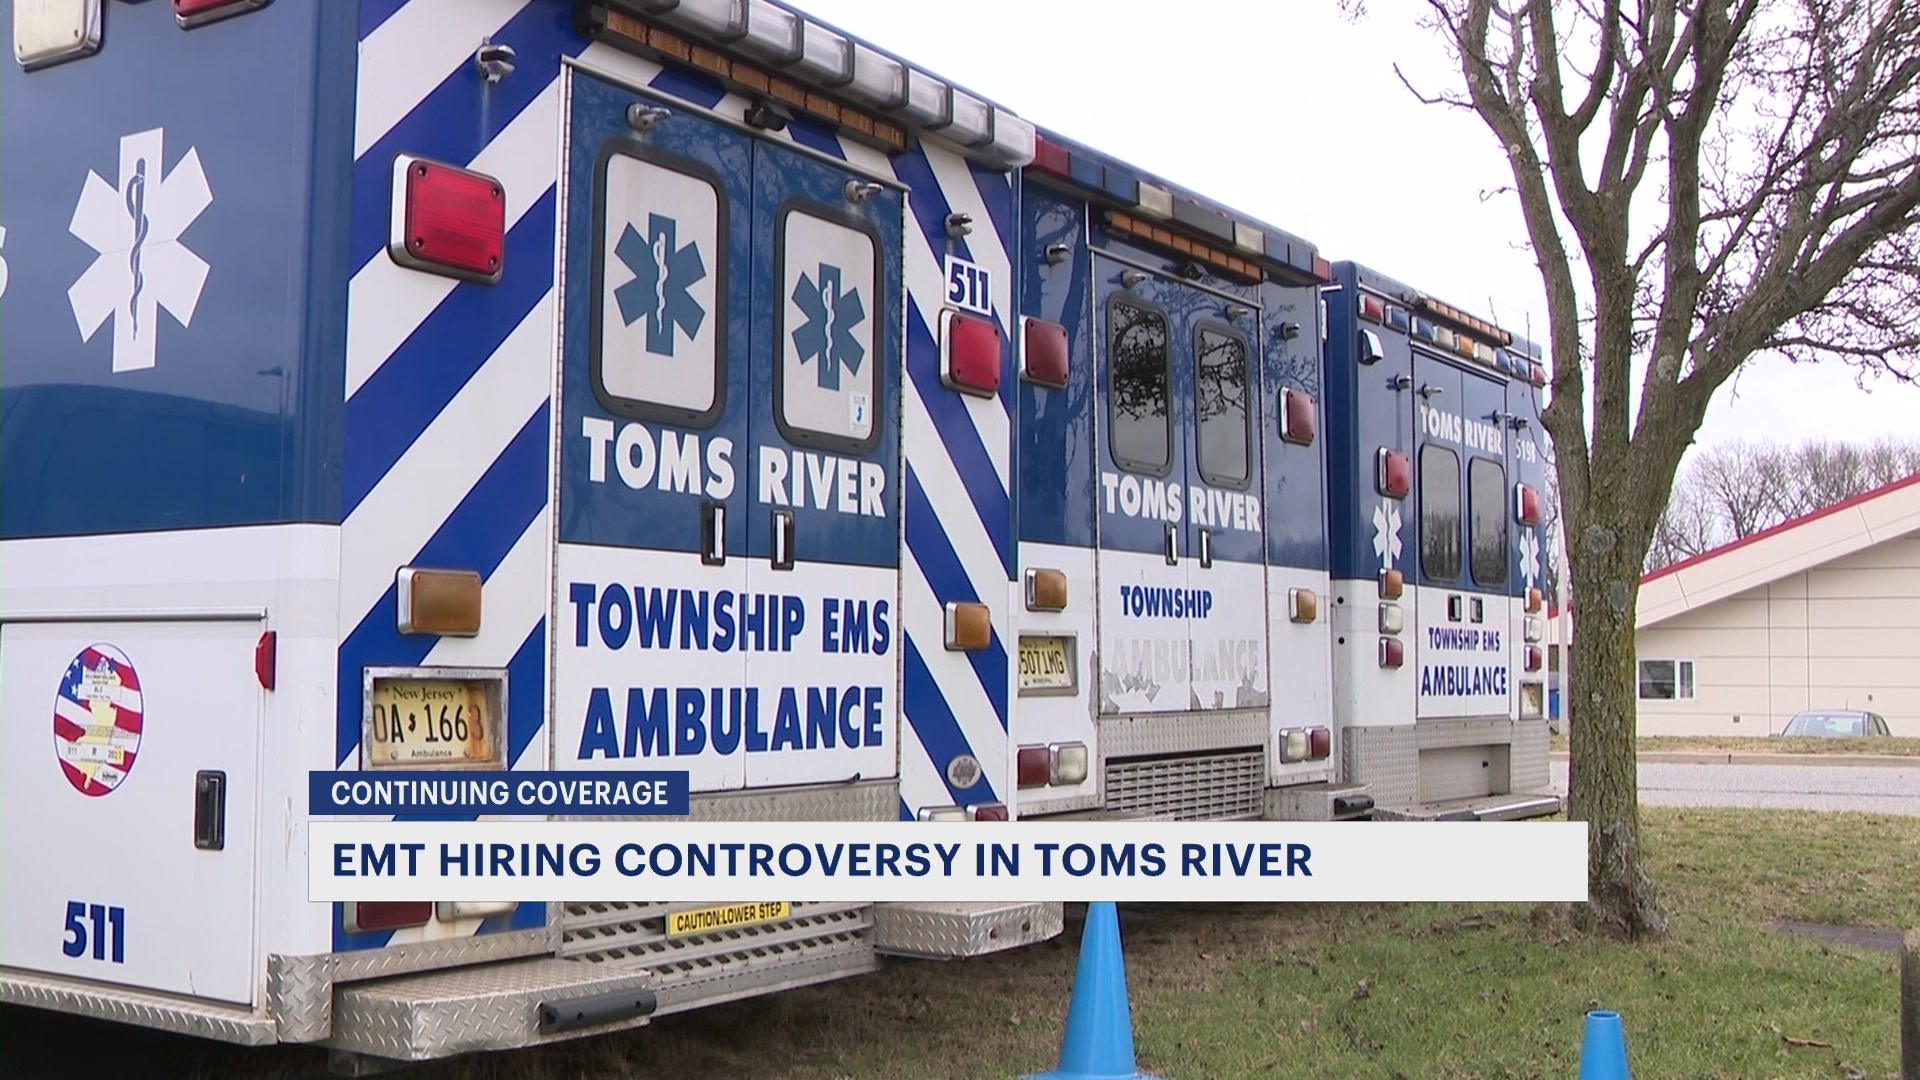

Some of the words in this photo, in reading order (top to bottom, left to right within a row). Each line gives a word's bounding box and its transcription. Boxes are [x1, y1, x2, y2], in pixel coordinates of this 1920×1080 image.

[949, 262, 988, 311] 511
[1420, 404, 1461, 443] TOMS
[1464, 419, 1503, 455] RIVER
[582, 416, 735, 500] TOMS
[759, 445, 887, 517] RIVER
[1102, 472, 1183, 523] TOMS
[1190, 485, 1261, 532] RIVER
[570, 582, 806, 652] TOWNSHIP
[822, 599, 890, 656] EMS
[1120, 585, 1213, 618] TOWNSHIP
[1111, 639, 1262, 684] AMBULANCE
[1428, 626, 1480, 651] TOWNSHIP
[1482, 630, 1501, 653] EMS
[392, 686, 419, 700] New
[421, 686, 455, 702] Jersey
[1421, 665, 1507, 697] AMBULANCE
[577, 685, 884, 761] AMBULANCE
[411, 750, 453, 758] Ambulance
[62, 900, 125, 964] 511
[758, 901, 783, 919] STEP
